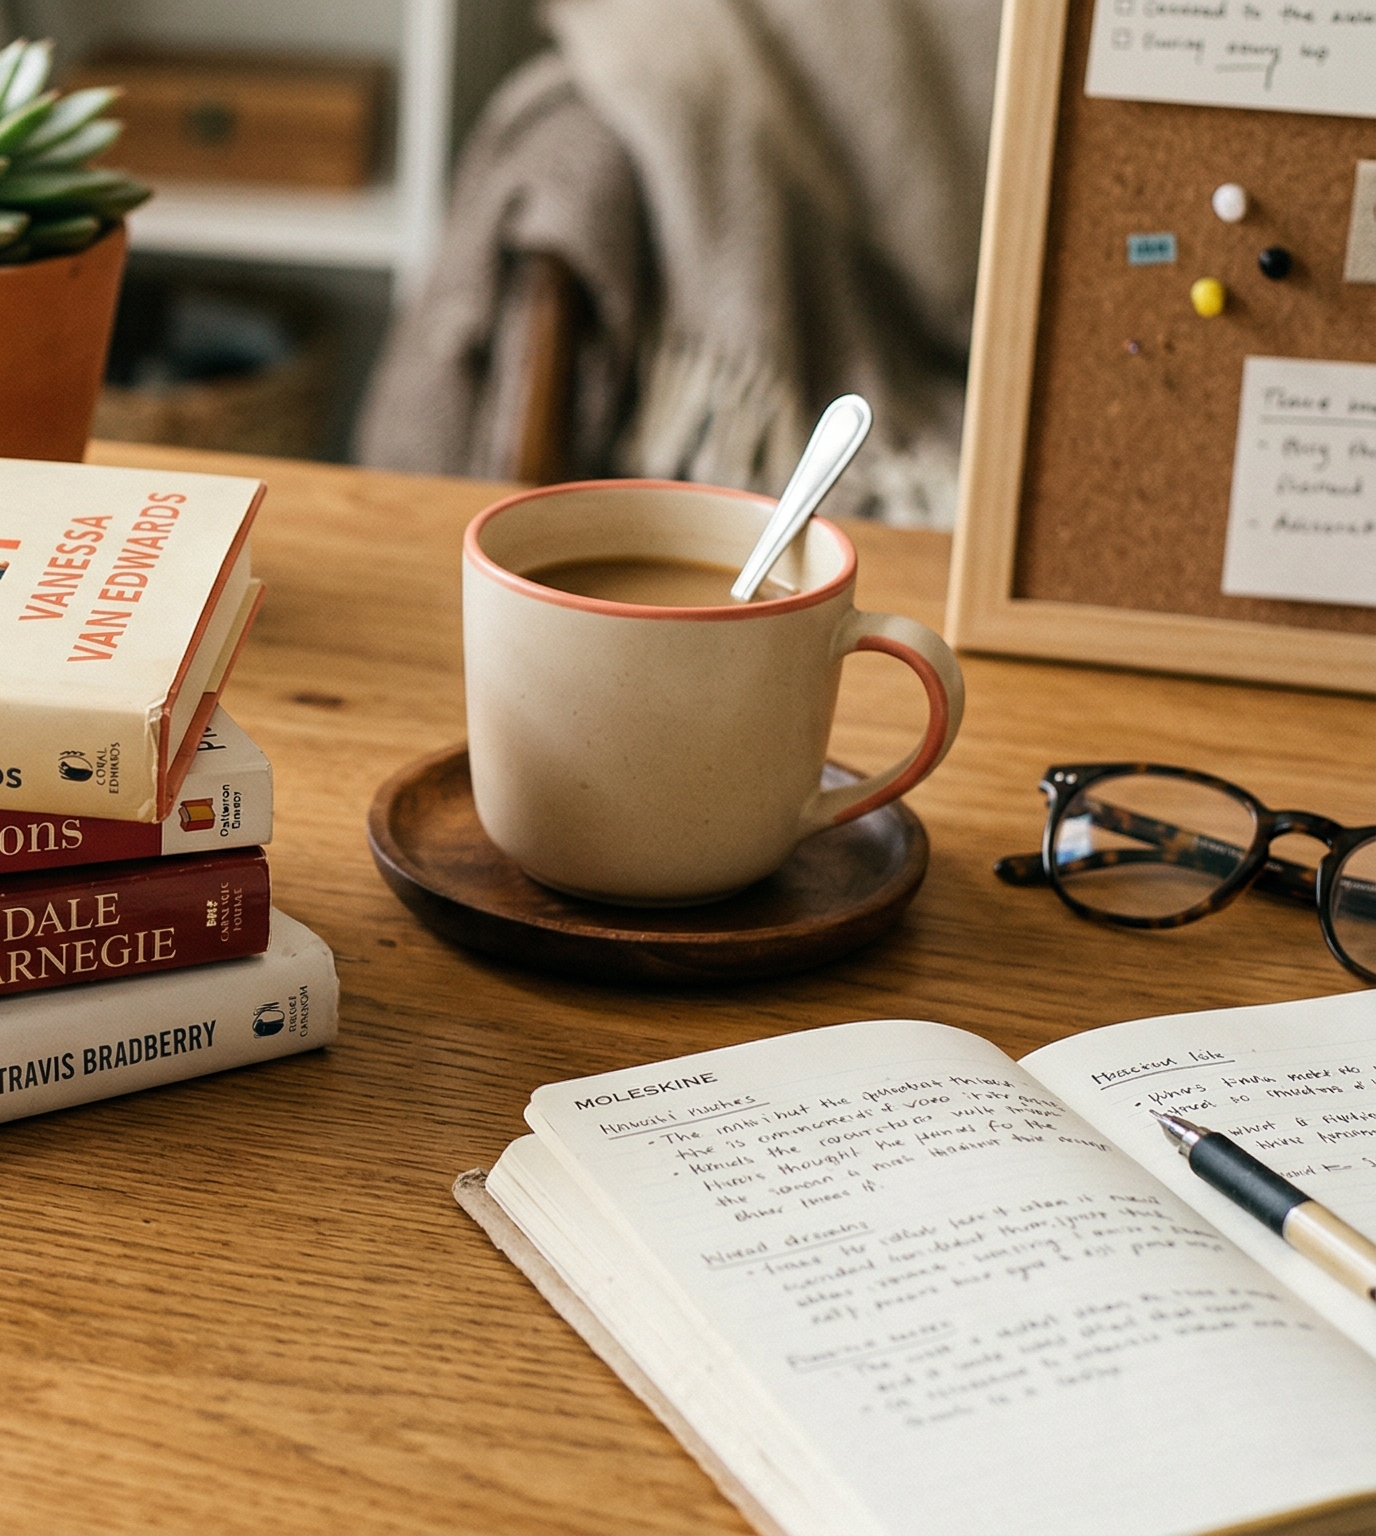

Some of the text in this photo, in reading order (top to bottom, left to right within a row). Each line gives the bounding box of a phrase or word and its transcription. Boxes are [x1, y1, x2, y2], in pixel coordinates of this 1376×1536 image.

[18, 515, 113, 621] VANESSA
[66, 492, 187, 662] VAN EDWARDS
[2, 892, 121, 942] DALE
[82, 1020, 216, 1075] BRADBERRY
[574, 1072, 718, 1110] MOLESKINE
